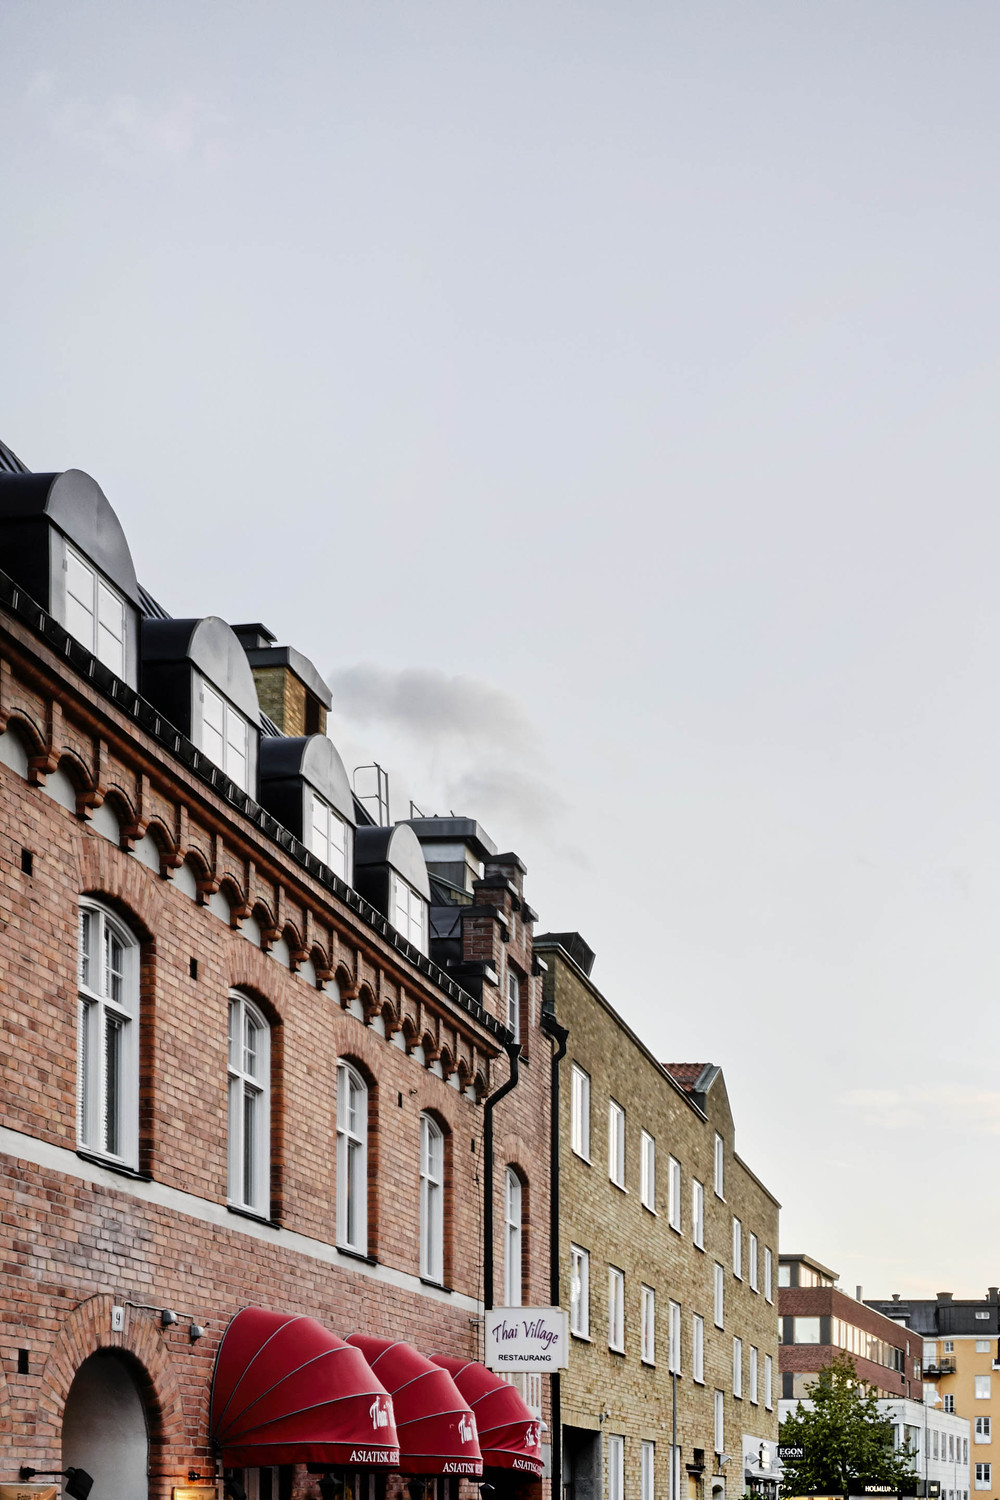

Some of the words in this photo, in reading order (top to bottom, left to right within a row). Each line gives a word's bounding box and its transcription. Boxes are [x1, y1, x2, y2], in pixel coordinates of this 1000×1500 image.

[115, 1311, 121, 1326] 9
[491, 1320, 519, 1343] Thai
[522, 1318, 559, 1351] Village
[350, 1449, 389, 1462] ASIATISK
[442, 1462, 475, 1473] ASIATISK
